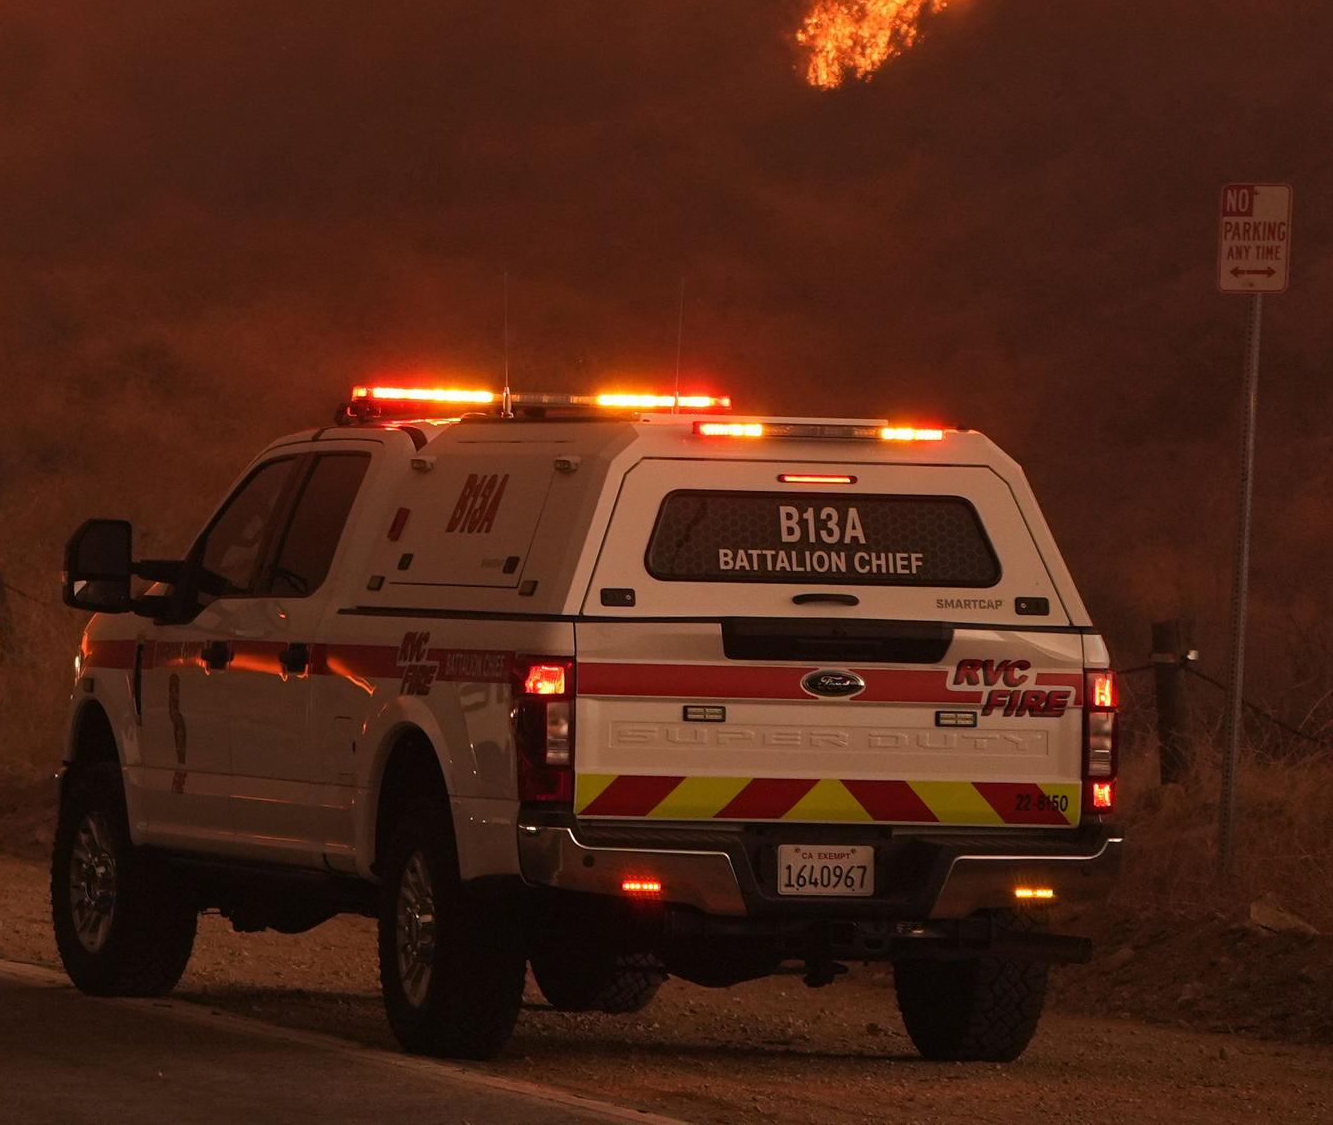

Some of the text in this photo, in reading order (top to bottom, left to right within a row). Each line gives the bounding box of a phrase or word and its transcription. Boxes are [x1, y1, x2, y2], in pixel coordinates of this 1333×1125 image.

[1226, 189, 1249, 212] NO
[1224, 221, 1286, 241] PARKING
[1227, 245, 1282, 261] ANY TIME
[445, 474, 510, 533] B13A
[779, 505, 866, 544] B13A
[718, 548, 924, 575] BATTALION CHIEF
[936, 599, 1003, 610] SMARTCAP
[953, 659, 1031, 687] RVC
[981, 690, 1071, 718] FIRE
[617, 728, 1042, 751] SUPER DUTY
[801, 852, 851, 860] CA EXEMPT
[784, 864, 867, 889] 1640967
